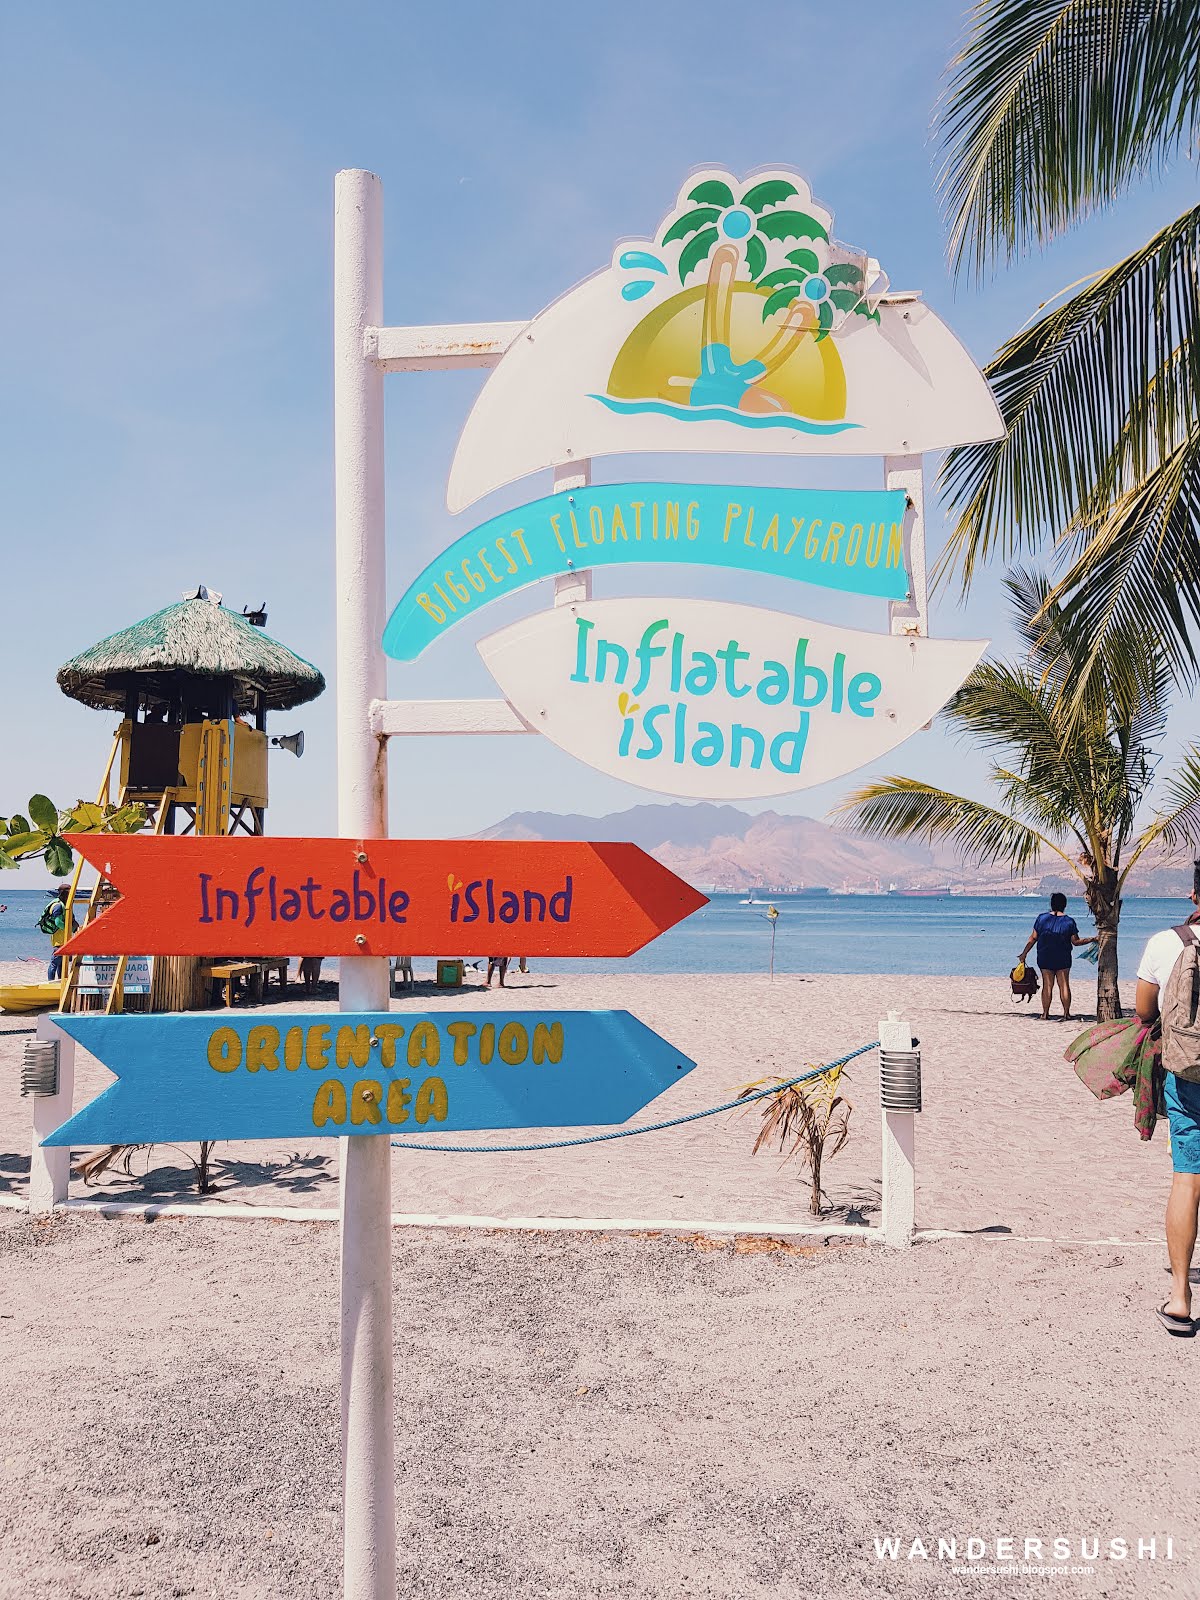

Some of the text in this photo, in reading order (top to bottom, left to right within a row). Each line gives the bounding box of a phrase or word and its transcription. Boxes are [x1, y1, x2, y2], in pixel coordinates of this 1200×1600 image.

[415, 528, 534, 626] BIGGEST
[549, 501, 700, 553] FLOATING
[569, 617, 883, 718] Inflatable
[198, 866, 411, 928] Inflatable
[206, 1021, 565, 1073] ORIENTATION
[312, 1077, 449, 1127] AREA
